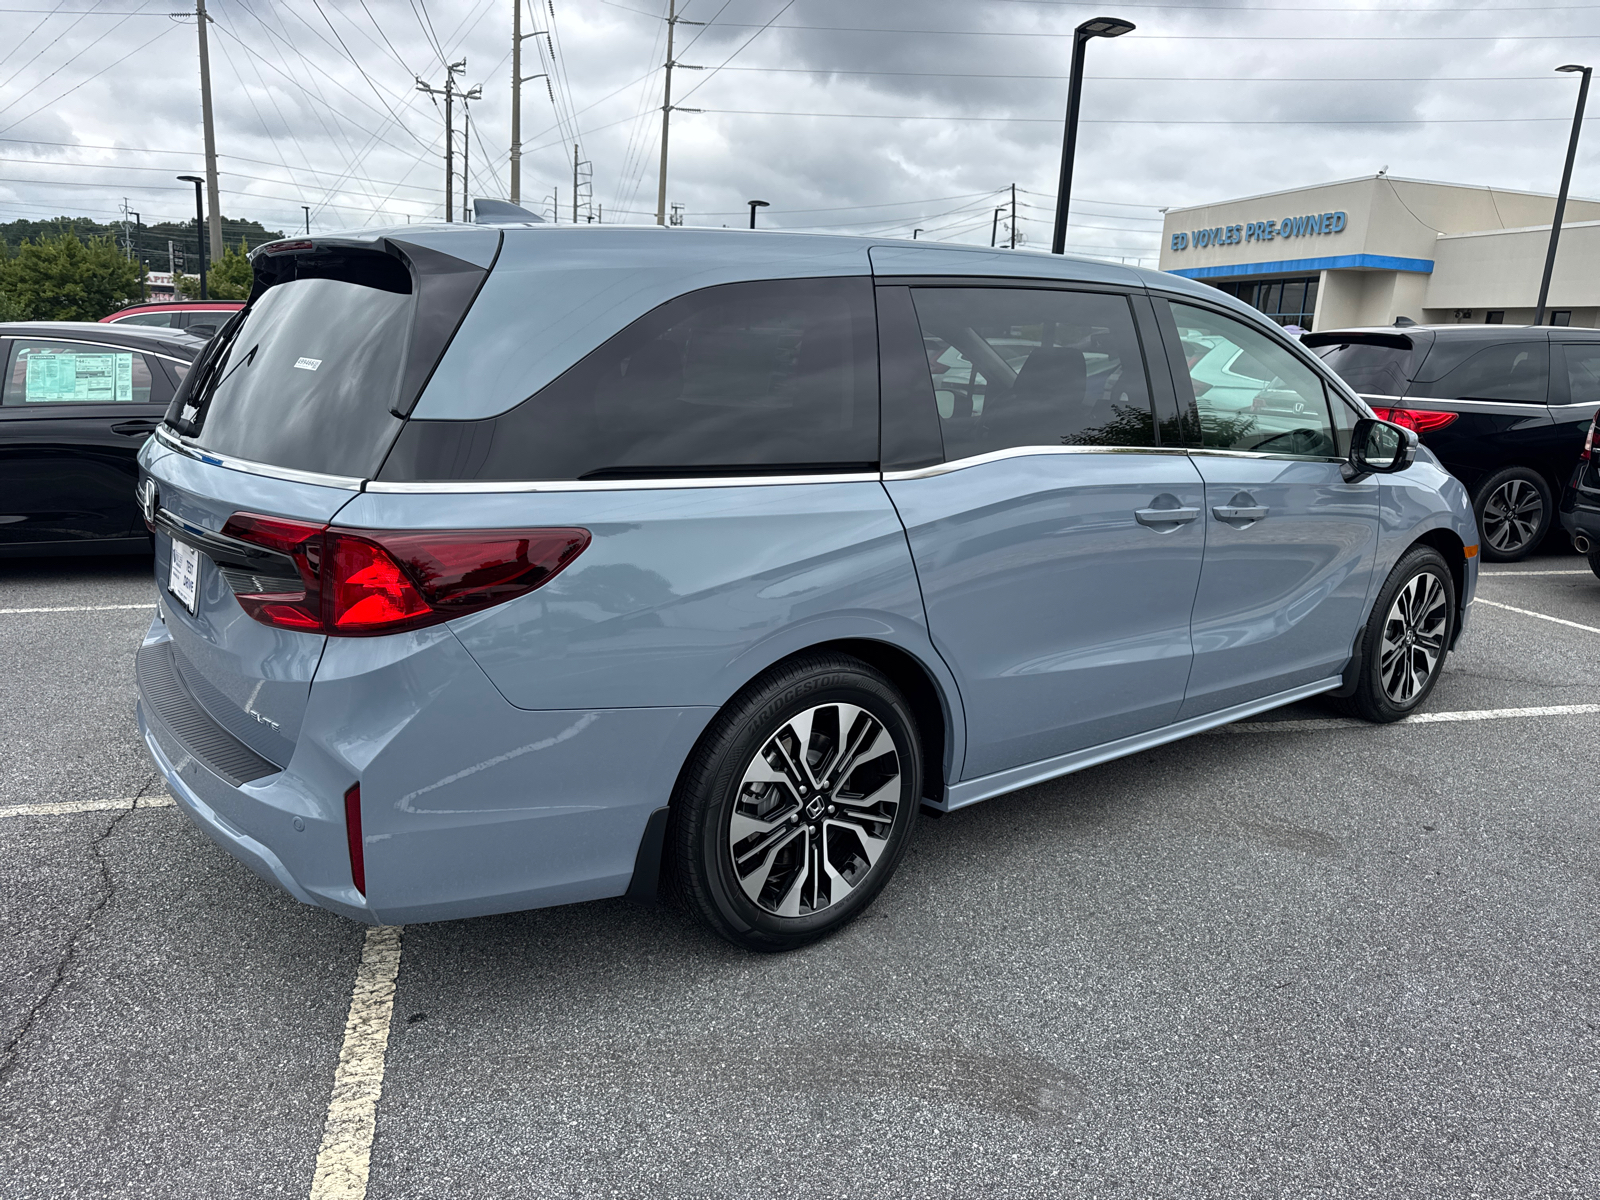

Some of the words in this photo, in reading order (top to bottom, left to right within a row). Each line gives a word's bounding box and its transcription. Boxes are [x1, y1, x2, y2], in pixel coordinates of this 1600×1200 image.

[1171, 233, 1188, 250] ED
[1192, 224, 1242, 248] VOYLES
[1245, 211, 1347, 242] PRE-OWNED
[747, 674, 850, 737] BRIDGESTONE
